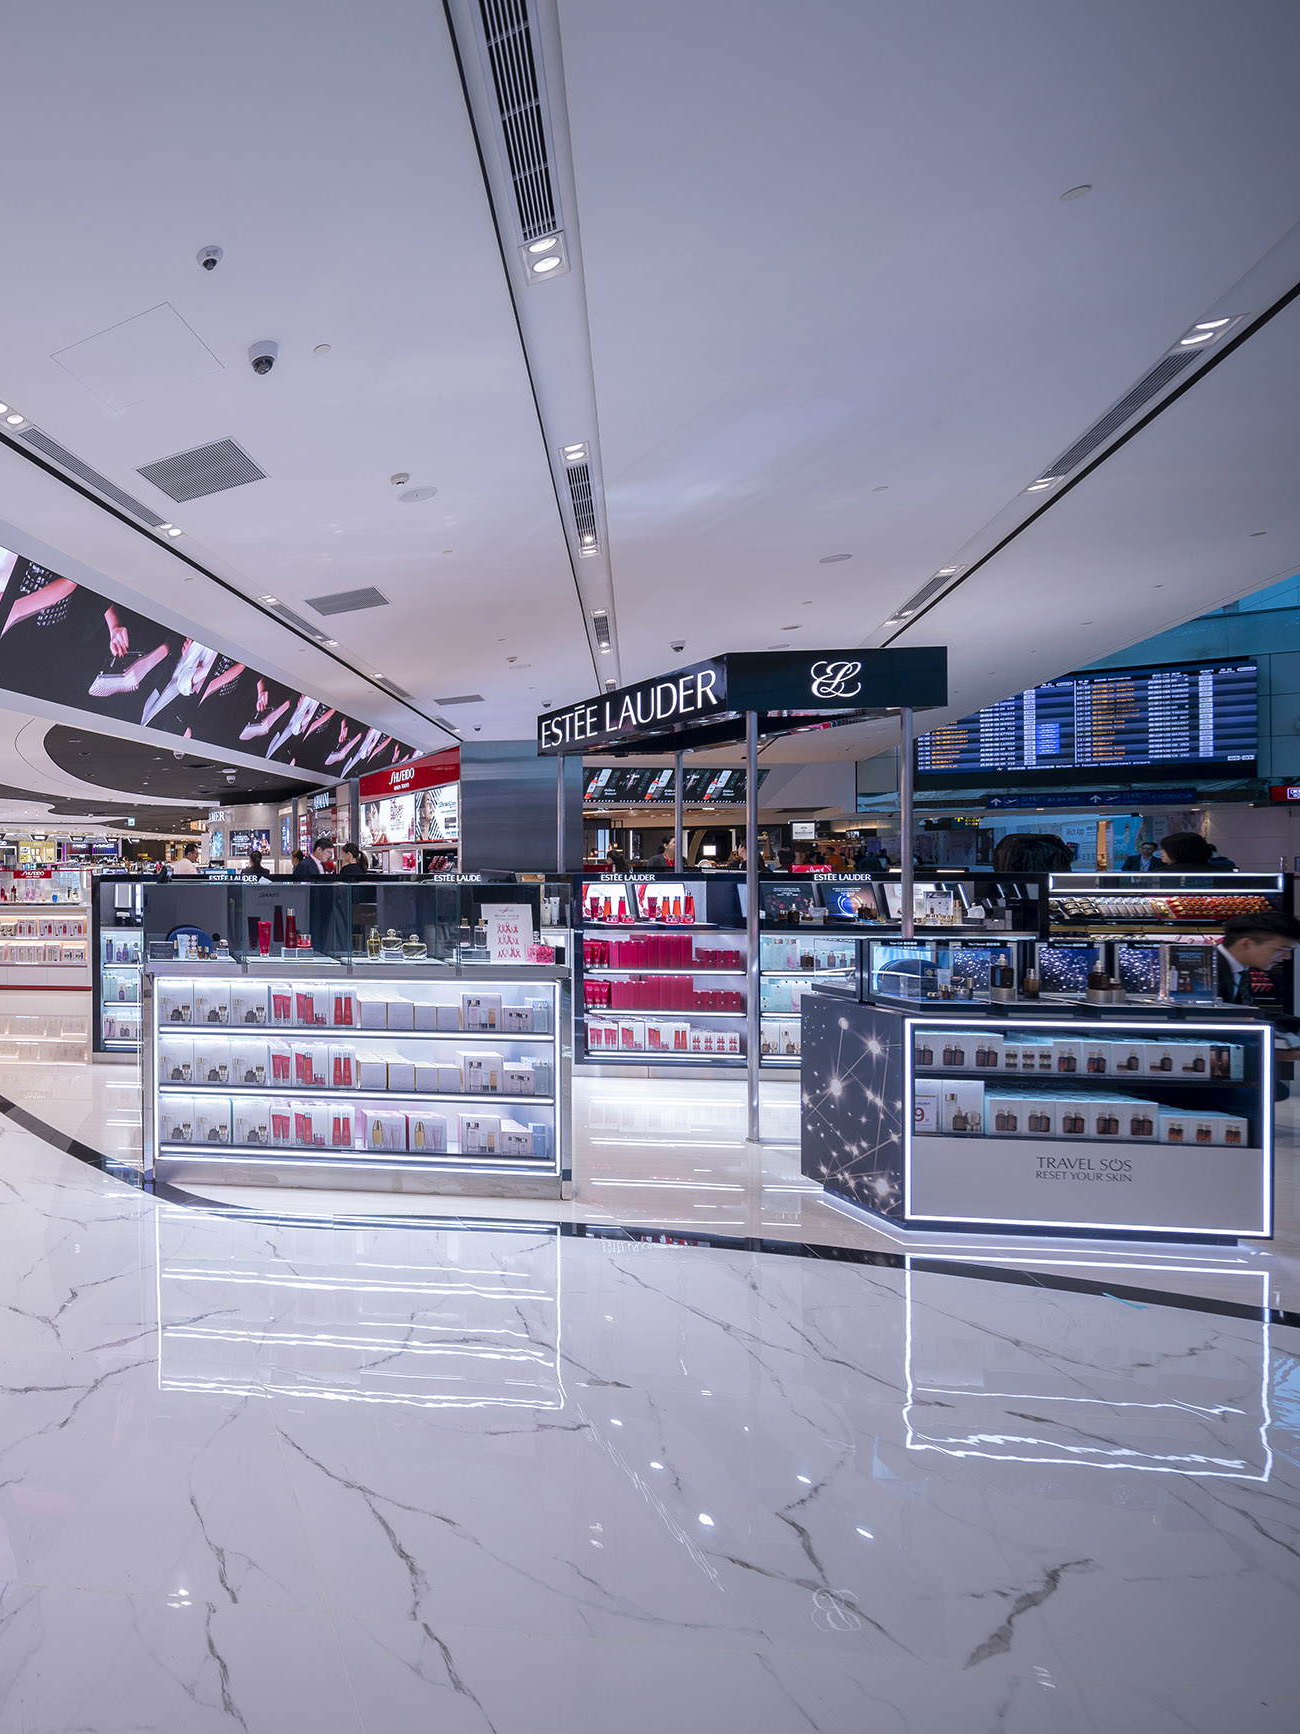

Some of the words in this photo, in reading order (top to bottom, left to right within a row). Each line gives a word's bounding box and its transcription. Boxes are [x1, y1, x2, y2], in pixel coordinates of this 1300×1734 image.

[605, 669, 718, 732] LAUDER
[389, 767, 415, 785] SHISEIDO
[456, 874, 481, 882] LAUDE
[838, 873, 871, 881] LAUDER
[1035, 1156, 1095, 1170] TRAVEL
[1099, 1158, 1132, 1172] SOS
[1035, 1170, 1068, 1180] RESET
[1070, 1172, 1103, 1181] YOUR
[1105, 1173, 1133, 1182] SKIN
